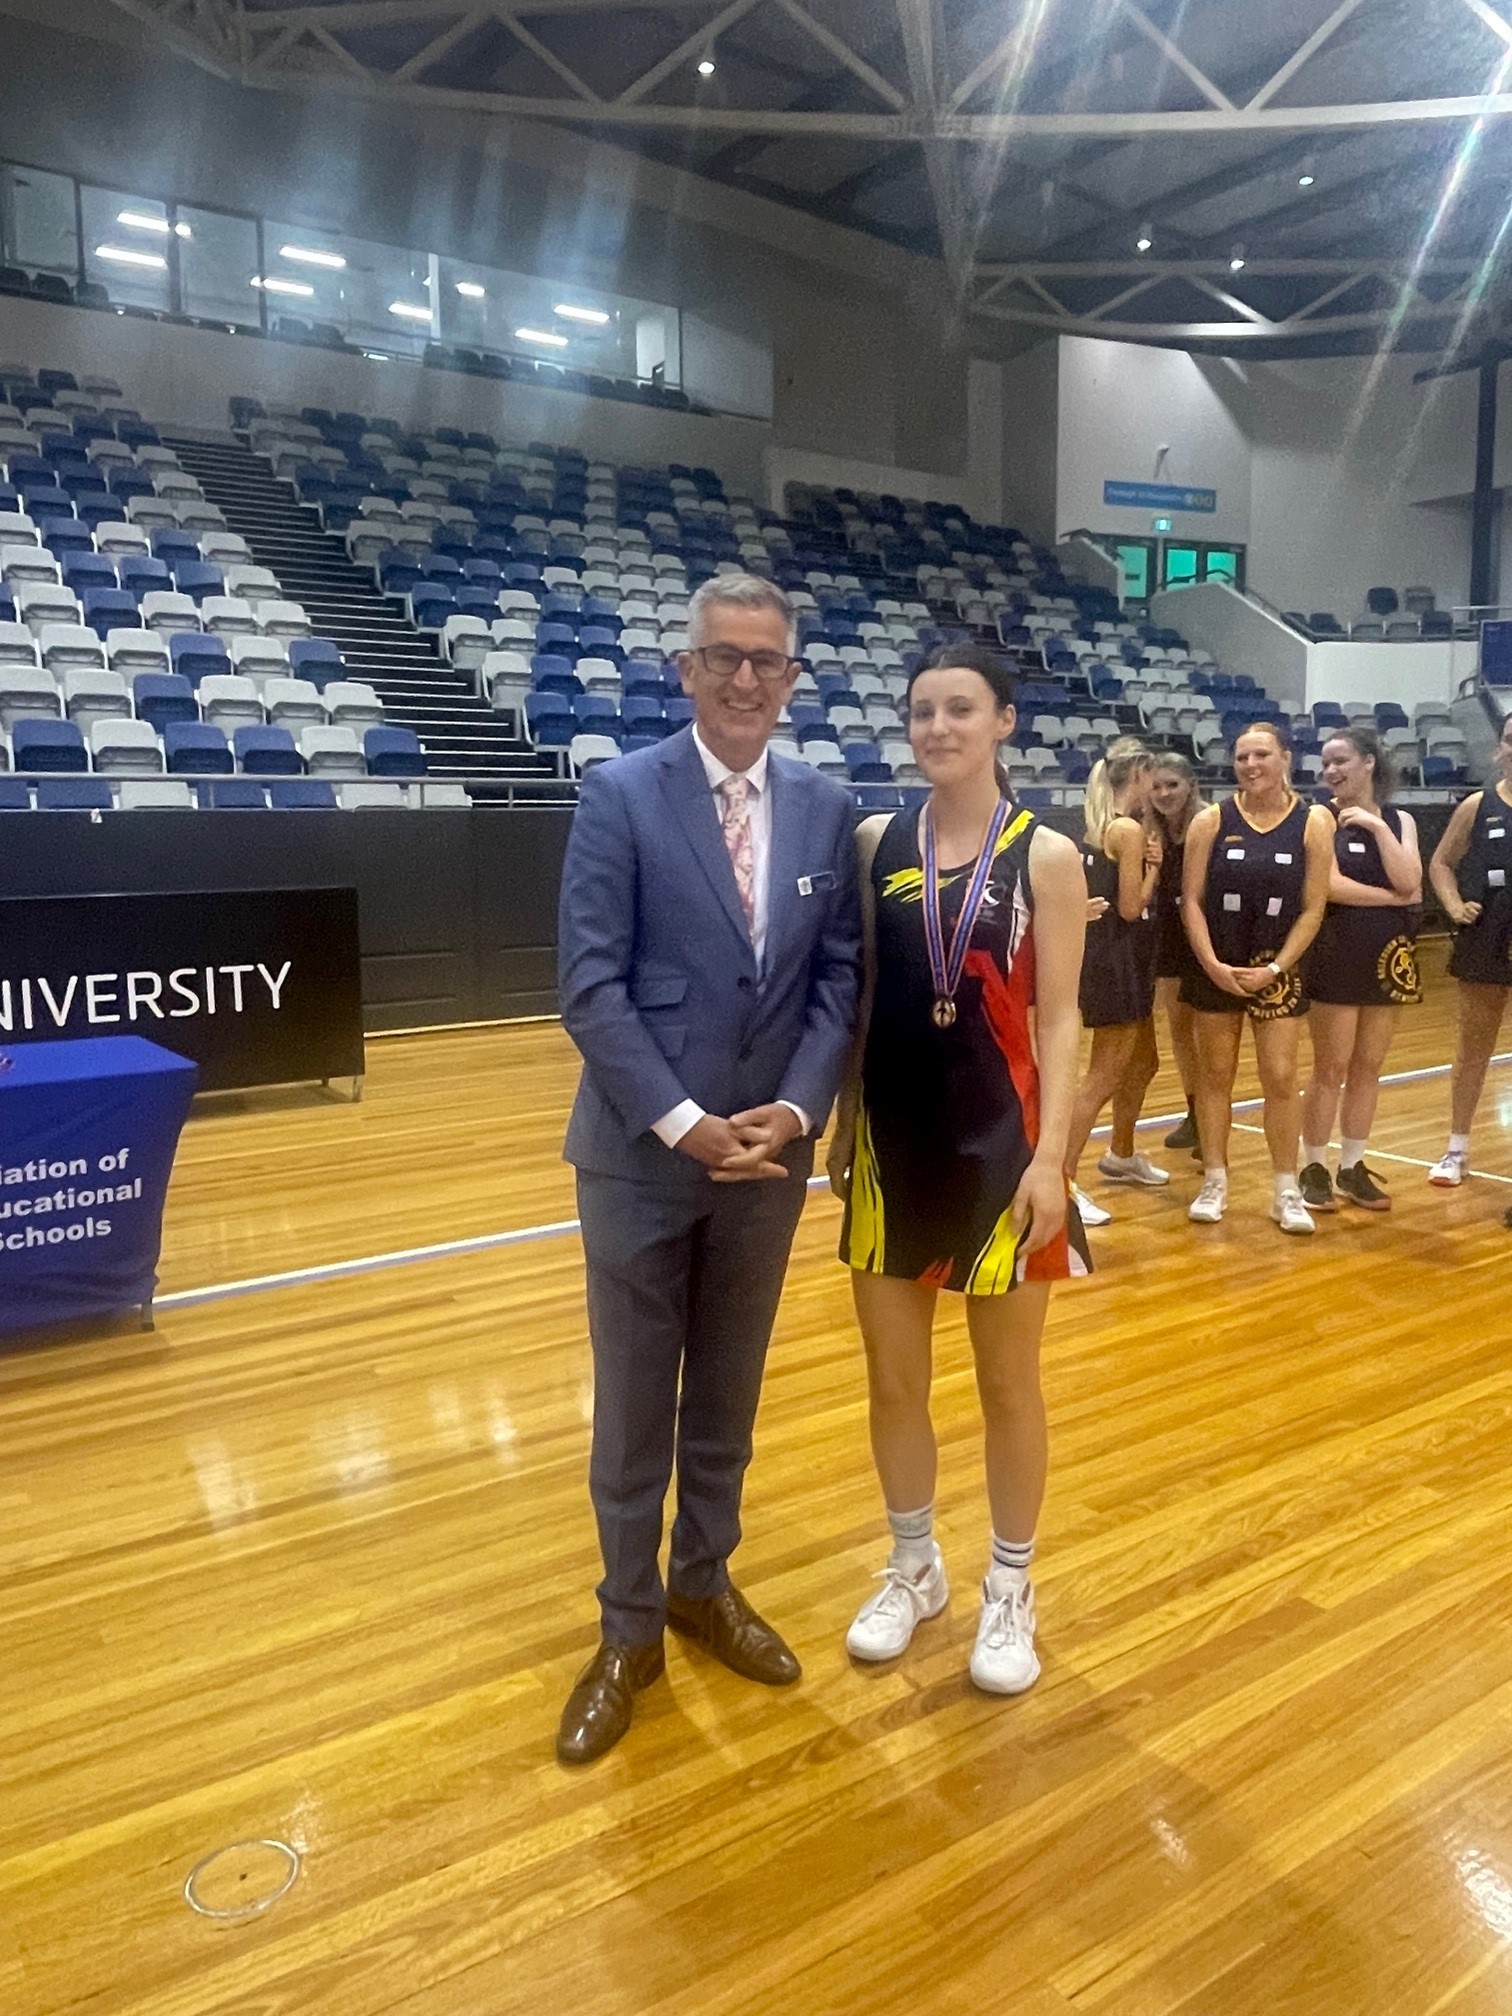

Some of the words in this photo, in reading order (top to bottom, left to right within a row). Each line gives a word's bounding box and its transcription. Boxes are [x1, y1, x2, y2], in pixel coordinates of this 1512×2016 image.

[0, 1158, 87, 1185] ation
[98, 1147, 130, 1172] of
[0, 1216, 112, 1252] chools
